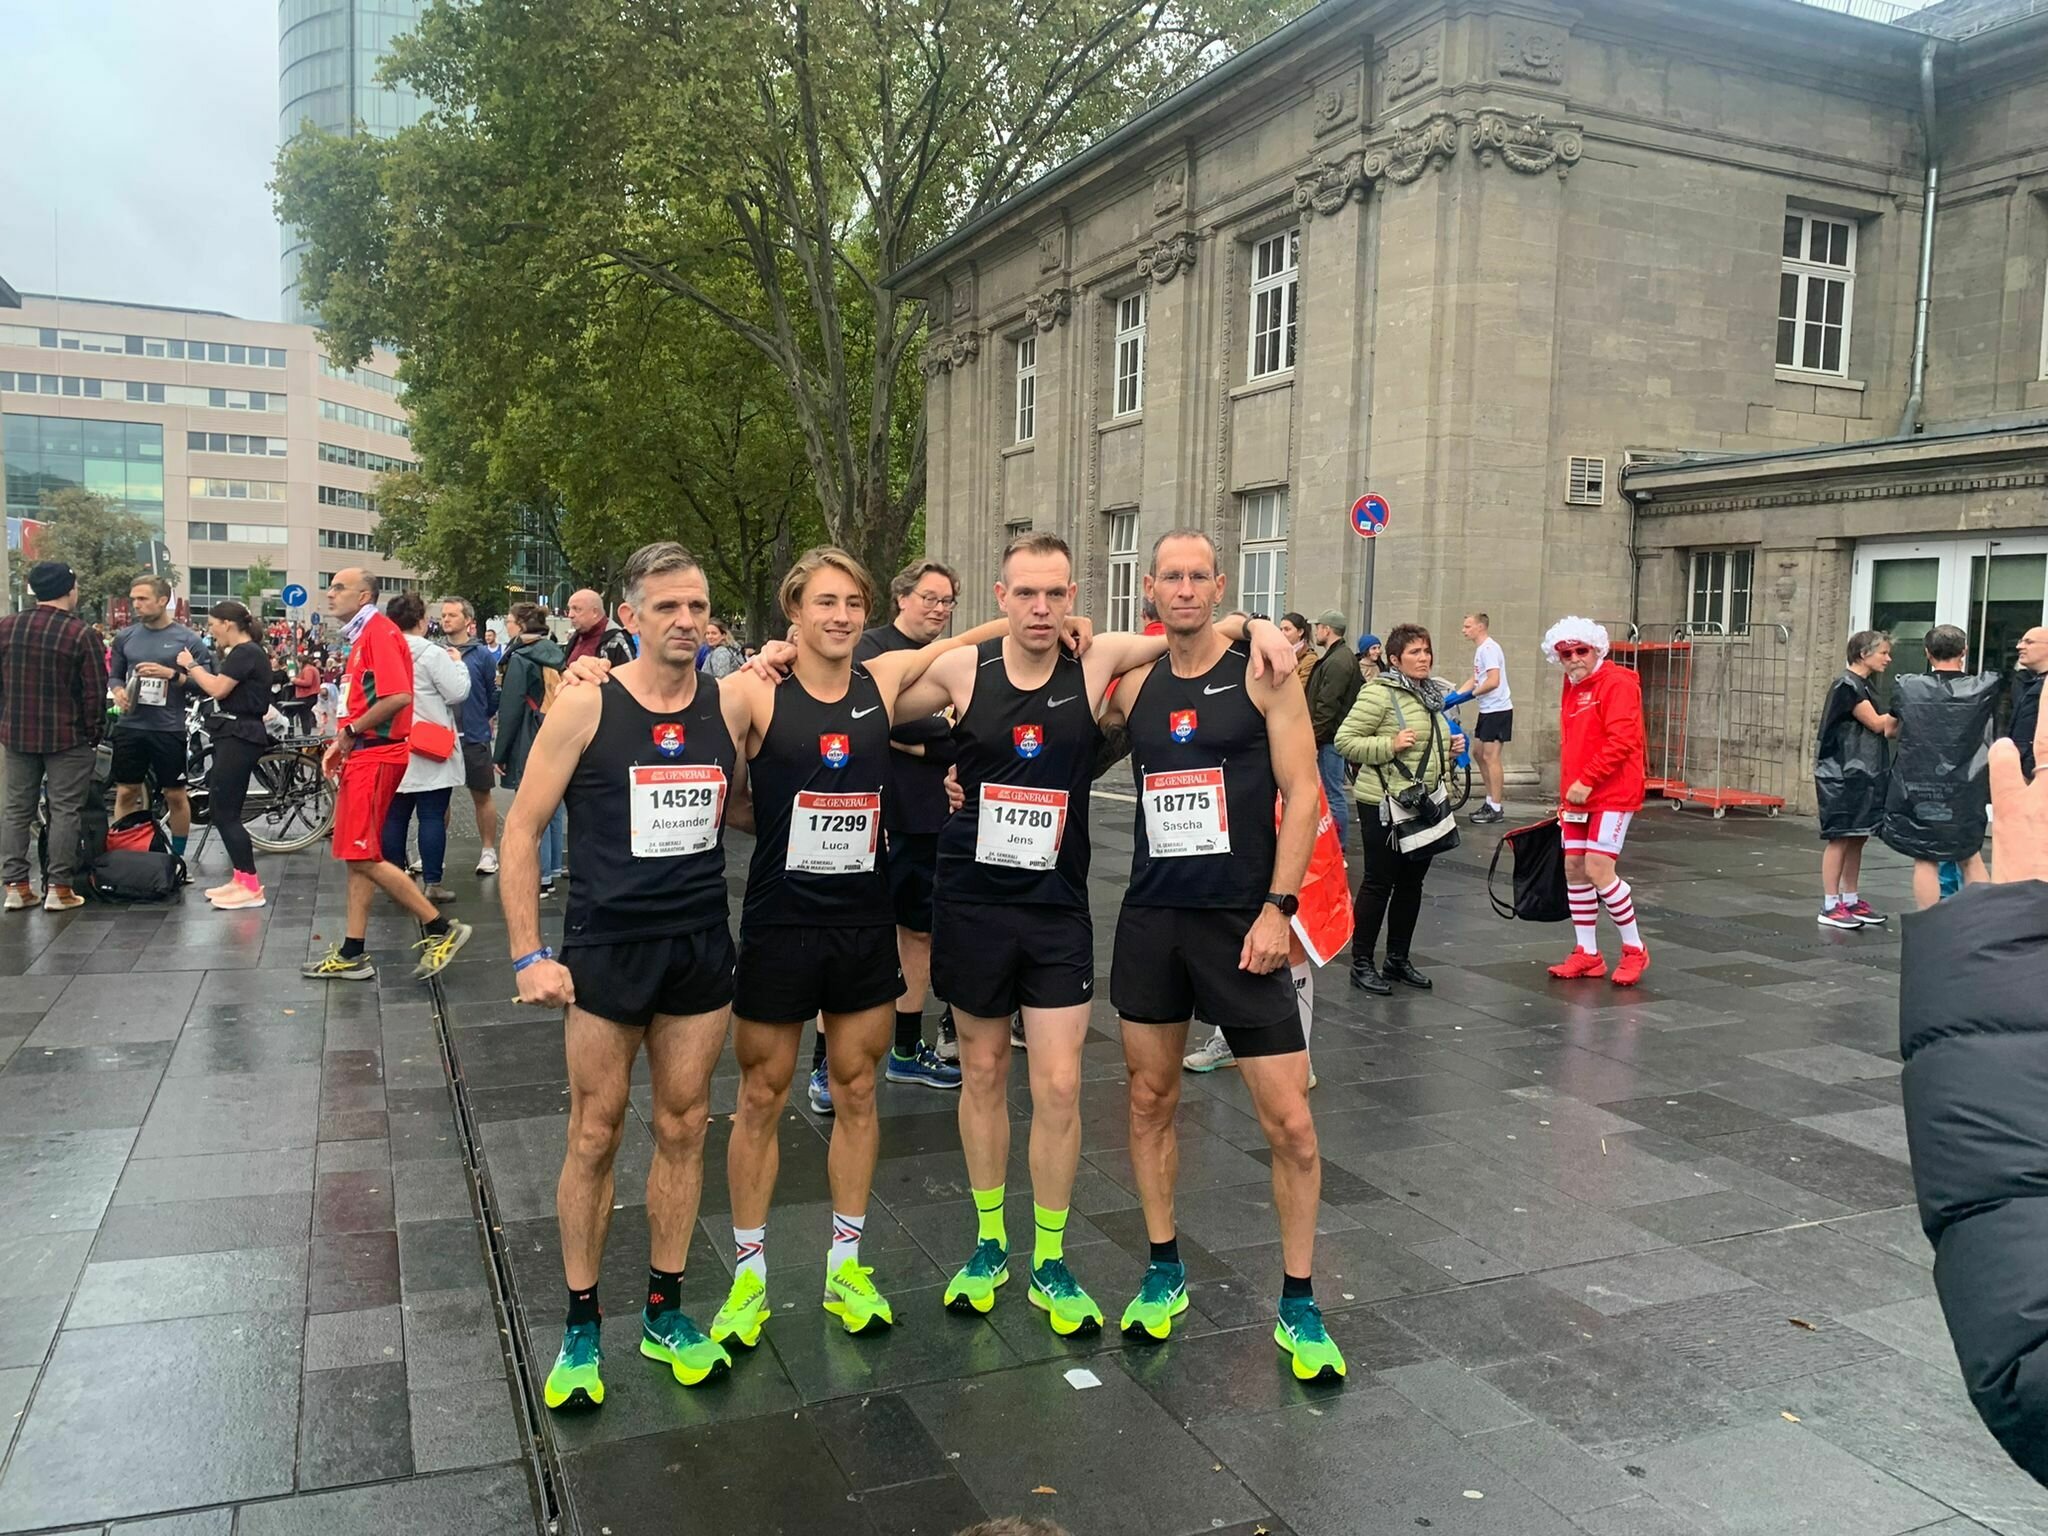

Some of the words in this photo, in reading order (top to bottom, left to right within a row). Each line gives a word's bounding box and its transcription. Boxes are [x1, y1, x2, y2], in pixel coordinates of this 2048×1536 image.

[665, 769, 711, 780] GENERALI
[1165, 773, 1207, 786] GENERALI
[649, 788, 712, 809] 14529
[827, 797, 868, 807] GENERALI
[1011, 791, 1054, 803] GENERALI
[1153, 792, 1210, 813] 18775
[652, 816, 709, 829] Alexander
[809, 814, 867, 832] 17299
[994, 806, 1052, 828] 14780
[1162, 820, 1203, 831] Sascha
[822, 840, 849, 850] Luca
[1007, 833, 1034, 845] Jens
